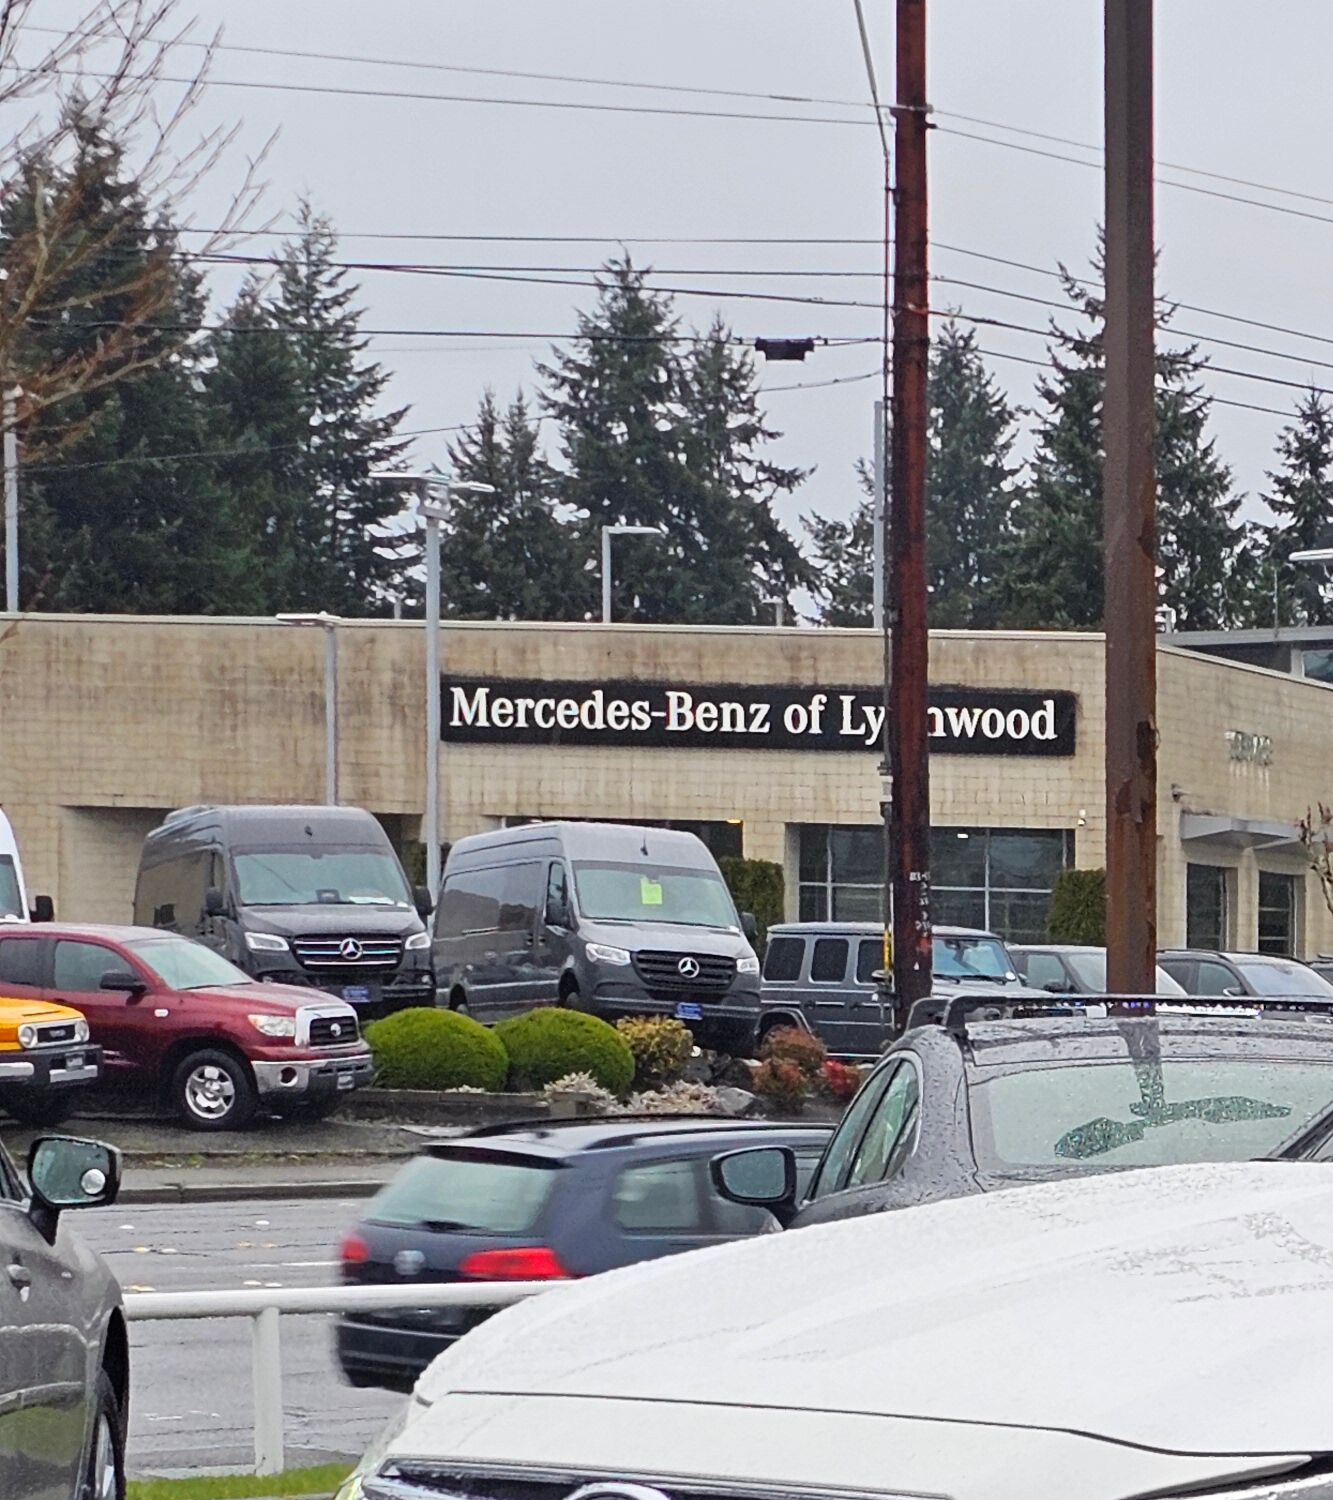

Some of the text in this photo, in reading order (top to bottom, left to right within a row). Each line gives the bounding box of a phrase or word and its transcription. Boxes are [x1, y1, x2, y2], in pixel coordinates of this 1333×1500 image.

[449, 687, 1058, 746] Mercedes-Benz of Lynwood
